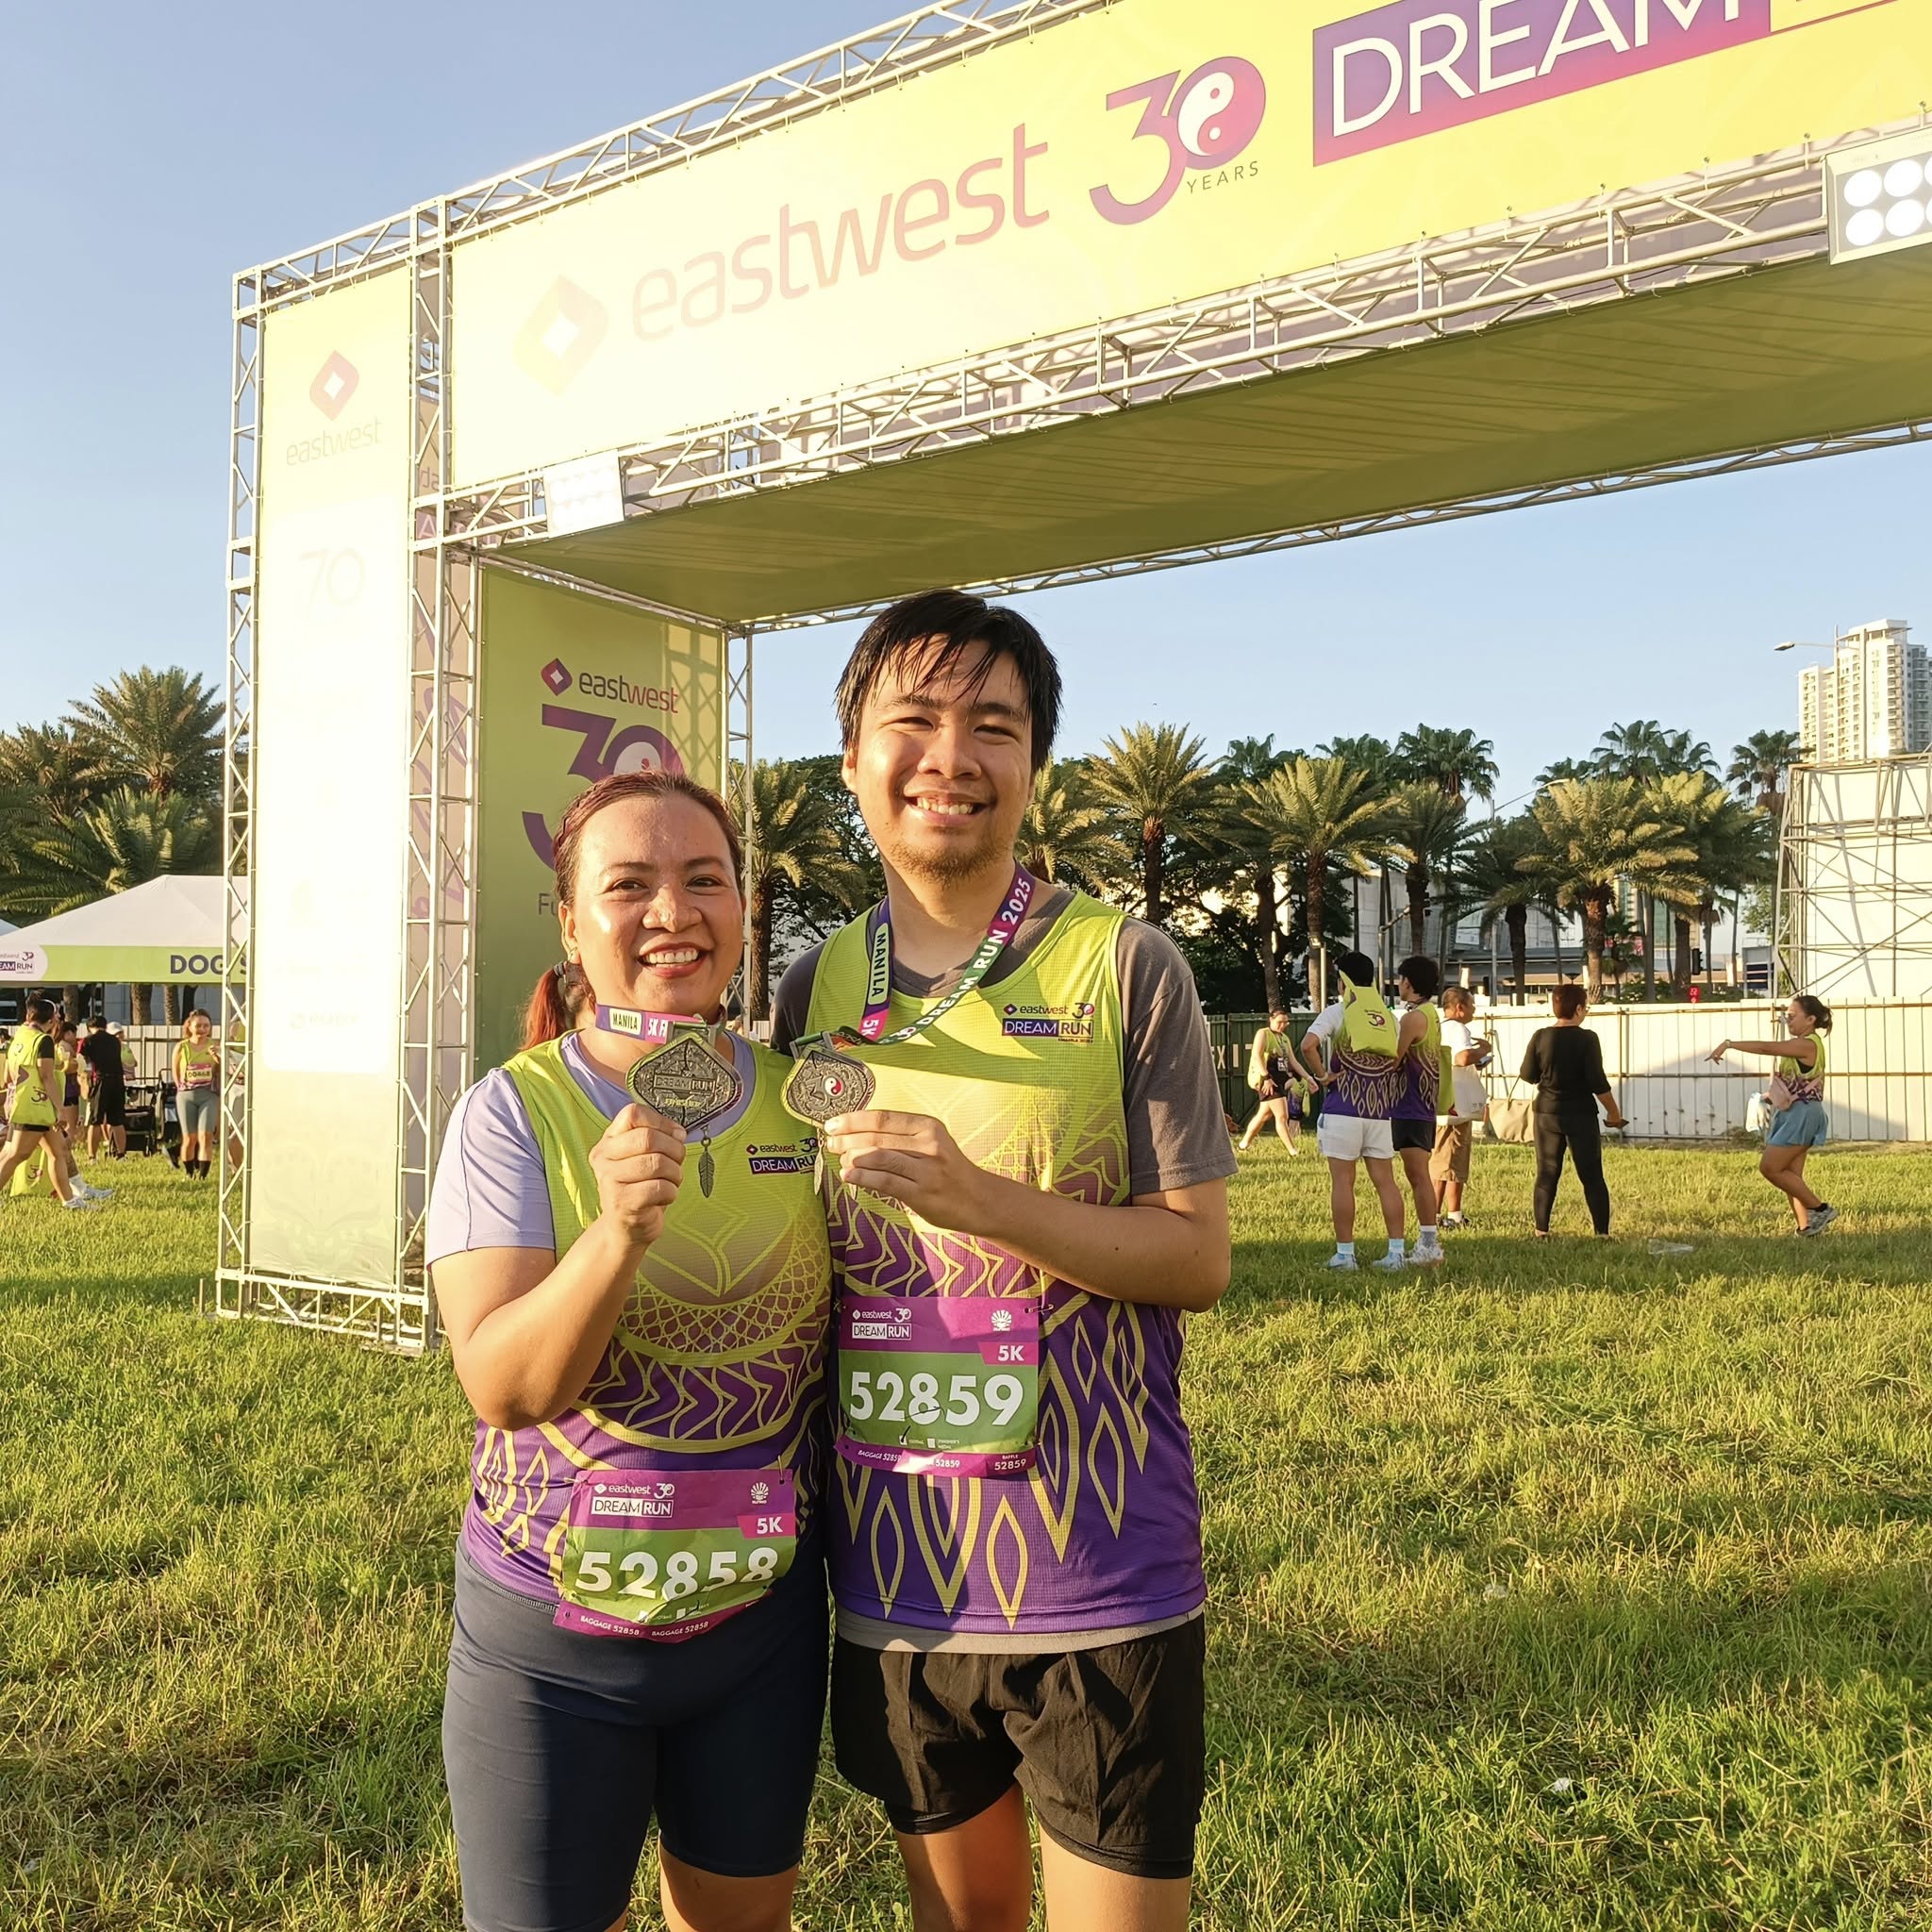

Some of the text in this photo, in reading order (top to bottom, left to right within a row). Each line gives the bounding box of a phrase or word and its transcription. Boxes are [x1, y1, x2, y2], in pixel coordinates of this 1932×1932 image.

[1186, 159, 1259, 194] YEARS
[631, 122, 1050, 341] eastwest
[1089, 55, 1267, 226] 30
[286, 415, 384, 466] eastwest
[578, 671, 679, 714] eastwest
[916, 975, 979, 1025] DREAM
[973, 929, 1008, 970] RUN
[1001, 877, 1031, 925] 2025
[871, 932, 887, 997] MANILA
[1020, 1002, 1095, 1019] eastwest 30
[612, 1012, 639, 1031] MANILA
[861, 1019, 880, 1036] 5K
[1004, 1020, 1092, 1036] DREAM RUN
[655, 1075, 713, 1091] DREAM RUN
[759, 1142, 798, 1153] eastwest
[752, 1159, 796, 1173] DREAM
[862, 1307, 912, 1323] eastwest 30
[854, 1324, 910, 1338] DREAM RUN
[997, 1344, 1024, 1362] 5K
[849, 1371, 1024, 1427] 52859
[858, 1449, 882, 1460] BAGGAGE
[882, 1453, 902, 1463] 52859
[935, 1458, 960, 1468] 52859
[994, 1458, 1026, 1471] 52859
[608, 1482, 675, 1499] eastwest 30
[594, 1499, 672, 1516] DREAM RUN
[756, 1516, 784, 1535] 5K
[575, 1546, 778, 1602] 52858
[580, 1615, 640, 1637] BAGGAGE 52858
[651, 1621, 709, 1637] BAGGAGE 52858
